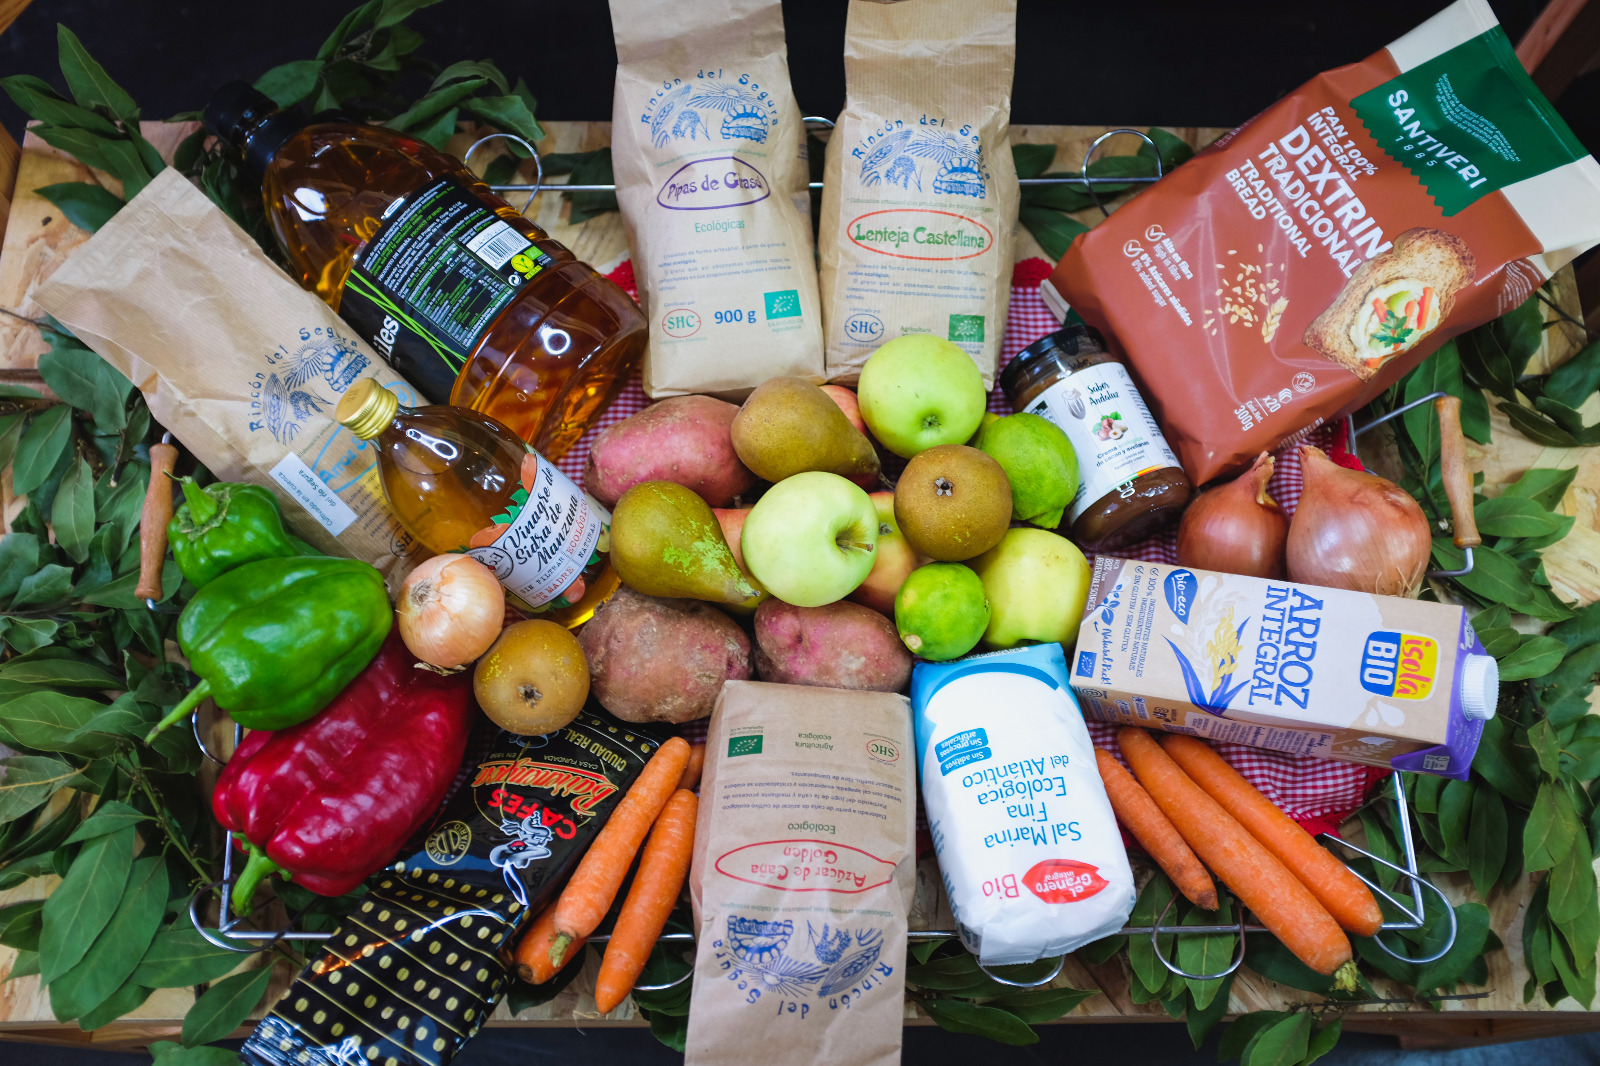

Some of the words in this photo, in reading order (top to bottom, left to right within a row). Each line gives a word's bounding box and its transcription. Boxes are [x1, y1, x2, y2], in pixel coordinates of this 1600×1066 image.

[641, 78, 681, 124] Rincón
[697, 69, 722, 79] del
[738, 73, 778, 126] Segura
[851, 120, 903, 160] Rincón
[919, 114, 945, 128] del
[1307, 112, 1362, 181] INTEGRAL
[1321, 106, 1348, 138] PAN
[1343, 139, 1378, 175] 100%
[1389, 90, 1487, 188] SANTIVERI
[667, 182, 698, 201] Pipas
[701, 175, 719, 191] de
[1225, 168, 1266, 220] BREAD
[1279, 125, 1393, 265] DEXTRIN
[1235, 159, 1312, 258] TRADITIONAL
[1258, 142, 1367, 279] TRADICIONAL
[694, 220, 745, 233] Ecológicas
[854, 223, 910, 248] Lenteja
[913, 226, 985, 249] Castellana
[1153, 243, 1167, 260] High
[1163, 257, 1171, 266] in
[1168, 264, 1181, 281] fibre
[1161, 238, 1175, 254] Alto
[1172, 253, 1182, 263] en
[1178, 261, 1193, 279] fibra
[1131, 259, 1143, 272] 0%
[1139, 271, 1157, 291] added
[1151, 289, 1167, 307] sugar
[1140, 253, 1152, 267] 0%
[1148, 265, 1172, 297] Azúcares
[1169, 295, 1193, 326] añadidos
[667, 315, 696, 330] SHC
[714, 309, 743, 325] 900
[747, 310, 757, 324] g
[850, 320, 879, 335] SHC
[900, 325, 932, 334] Agricultura
[246, 370, 266, 435] Rincón
[262, 344, 290, 366] del
[1087, 382, 1110, 394] Sabor
[1089, 390, 1119, 405] Andaluz
[1262, 395, 1281, 412] x20
[1234, 405, 1254, 431] 300g
[1096, 446, 1118, 459] Crema
[1104, 451, 1122, 462] cacao
[1127, 441, 1149, 451] avellanas
[319, 449, 358, 485] Arroz
[278, 472, 297, 491] cuenca
[299, 470, 319, 491] Segura
[296, 489, 303, 497] la
[325, 497, 336, 507] del
[309, 502, 333, 527] Cultivado
[503, 487, 551, 549] Vinagre
[541, 467, 553, 486] de
[515, 524, 552, 565] Sidra
[545, 503, 561, 524] de
[537, 495, 578, 572] Manzana
[565, 498, 588, 555] ECOLÓGICO
[579, 523, 597, 558] NATURAL
[519, 584, 534, 598] SIN
[535, 556, 564, 586] FILTRAR
[545, 566, 573, 595] MADRE
[1091, 557, 1104, 589] RENEWABLE
[1133, 575, 1141, 585] SIN
[1086, 588, 1098, 612] SOURCES
[1129, 585, 1139, 610] GLUTEN
[1174, 573, 1190, 616] bio-eco
[1125, 614, 1133, 627] SEM
[1134, 597, 1148, 640] INGREDIENTES
[1142, 598, 1156, 642] INGREDIENTES
[1121, 628, 1131, 652] GLUTEN
[1248, 585, 1290, 706] INTEGRAL
[1274, 588, 1324, 709] ARROZ
[1128, 641, 1140, 671] NATURAIS
[1136, 642, 1148, 678] NATURALES
[1364, 640, 1397, 685] BIO
[1396, 639, 1438, 700] isola
[565, 733, 591, 749] REAL
[794, 741, 833, 750] Agricultura
[797, 732, 831, 740] ecológica
[938, 731, 976, 748] artificiales
[940, 739, 969, 757] procesos
[969, 738, 982, 746] Sin
[589, 743, 626, 772] CIUDAD
[870, 743, 894, 757] SHC
[971, 751, 984, 759] Sin
[1050, 755, 1069, 768] del
[544, 755, 578, 773] FUNDADA
[579, 761, 598, 775] CASA
[943, 755, 973, 770] aditivos
[962, 757, 1044, 788] Atlántico
[732, 791, 759, 799] procesos
[830, 794, 844, 802] jugo
[977, 773, 1067, 805] Ecológica
[834, 805, 851, 813] partir
[857, 799, 886, 809] Partiendo
[857, 809, 886, 819] Elaborado
[1006, 802, 1048, 822] Fina
[452, 822, 469, 852] DIARIO
[787, 820, 835, 834] Ecológico
[984, 825, 1048, 848] Marina
[1051, 821, 1082, 845] Sal
[782, 845, 837, 864] Golden
[750, 863, 788, 880] Caña
[794, 866, 810, 880] de
[815, 866, 865, 887] Azúcar
[1036, 873, 1092, 892] Granero
[1044, 871, 1075, 882] integral
[982, 874, 1020, 900] Bio
[712, 939, 760, 1003] Segura
[828, 961, 892, 1009] Rincón
[777, 1000, 809, 1019] del
